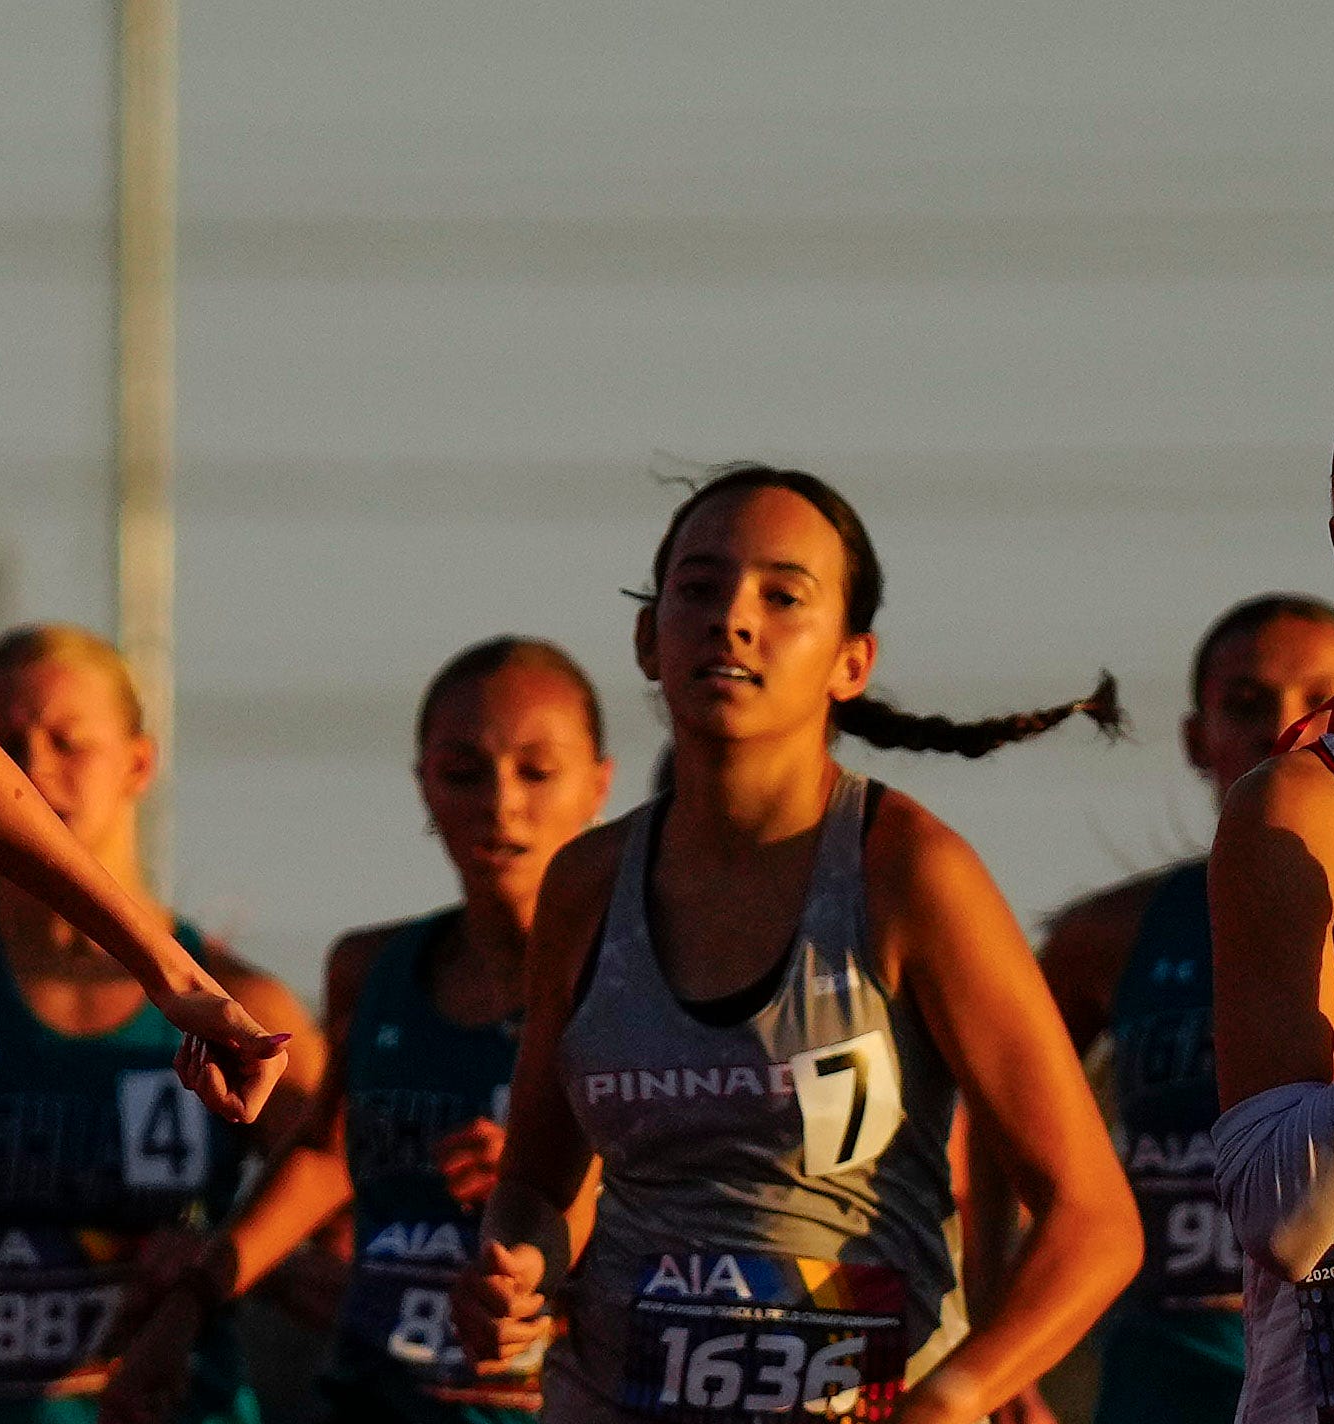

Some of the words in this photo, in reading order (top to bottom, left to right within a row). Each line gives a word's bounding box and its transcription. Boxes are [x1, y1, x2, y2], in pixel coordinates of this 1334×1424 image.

[585, 1062, 798, 1103] PINNAC
[814, 1052, 869, 1164] 7
[140, 1084, 193, 1177] 4
[365, 1222, 464, 1262] AIA
[643, 1254, 753, 1300] AIA
[659, 1326, 867, 1413] 1636
